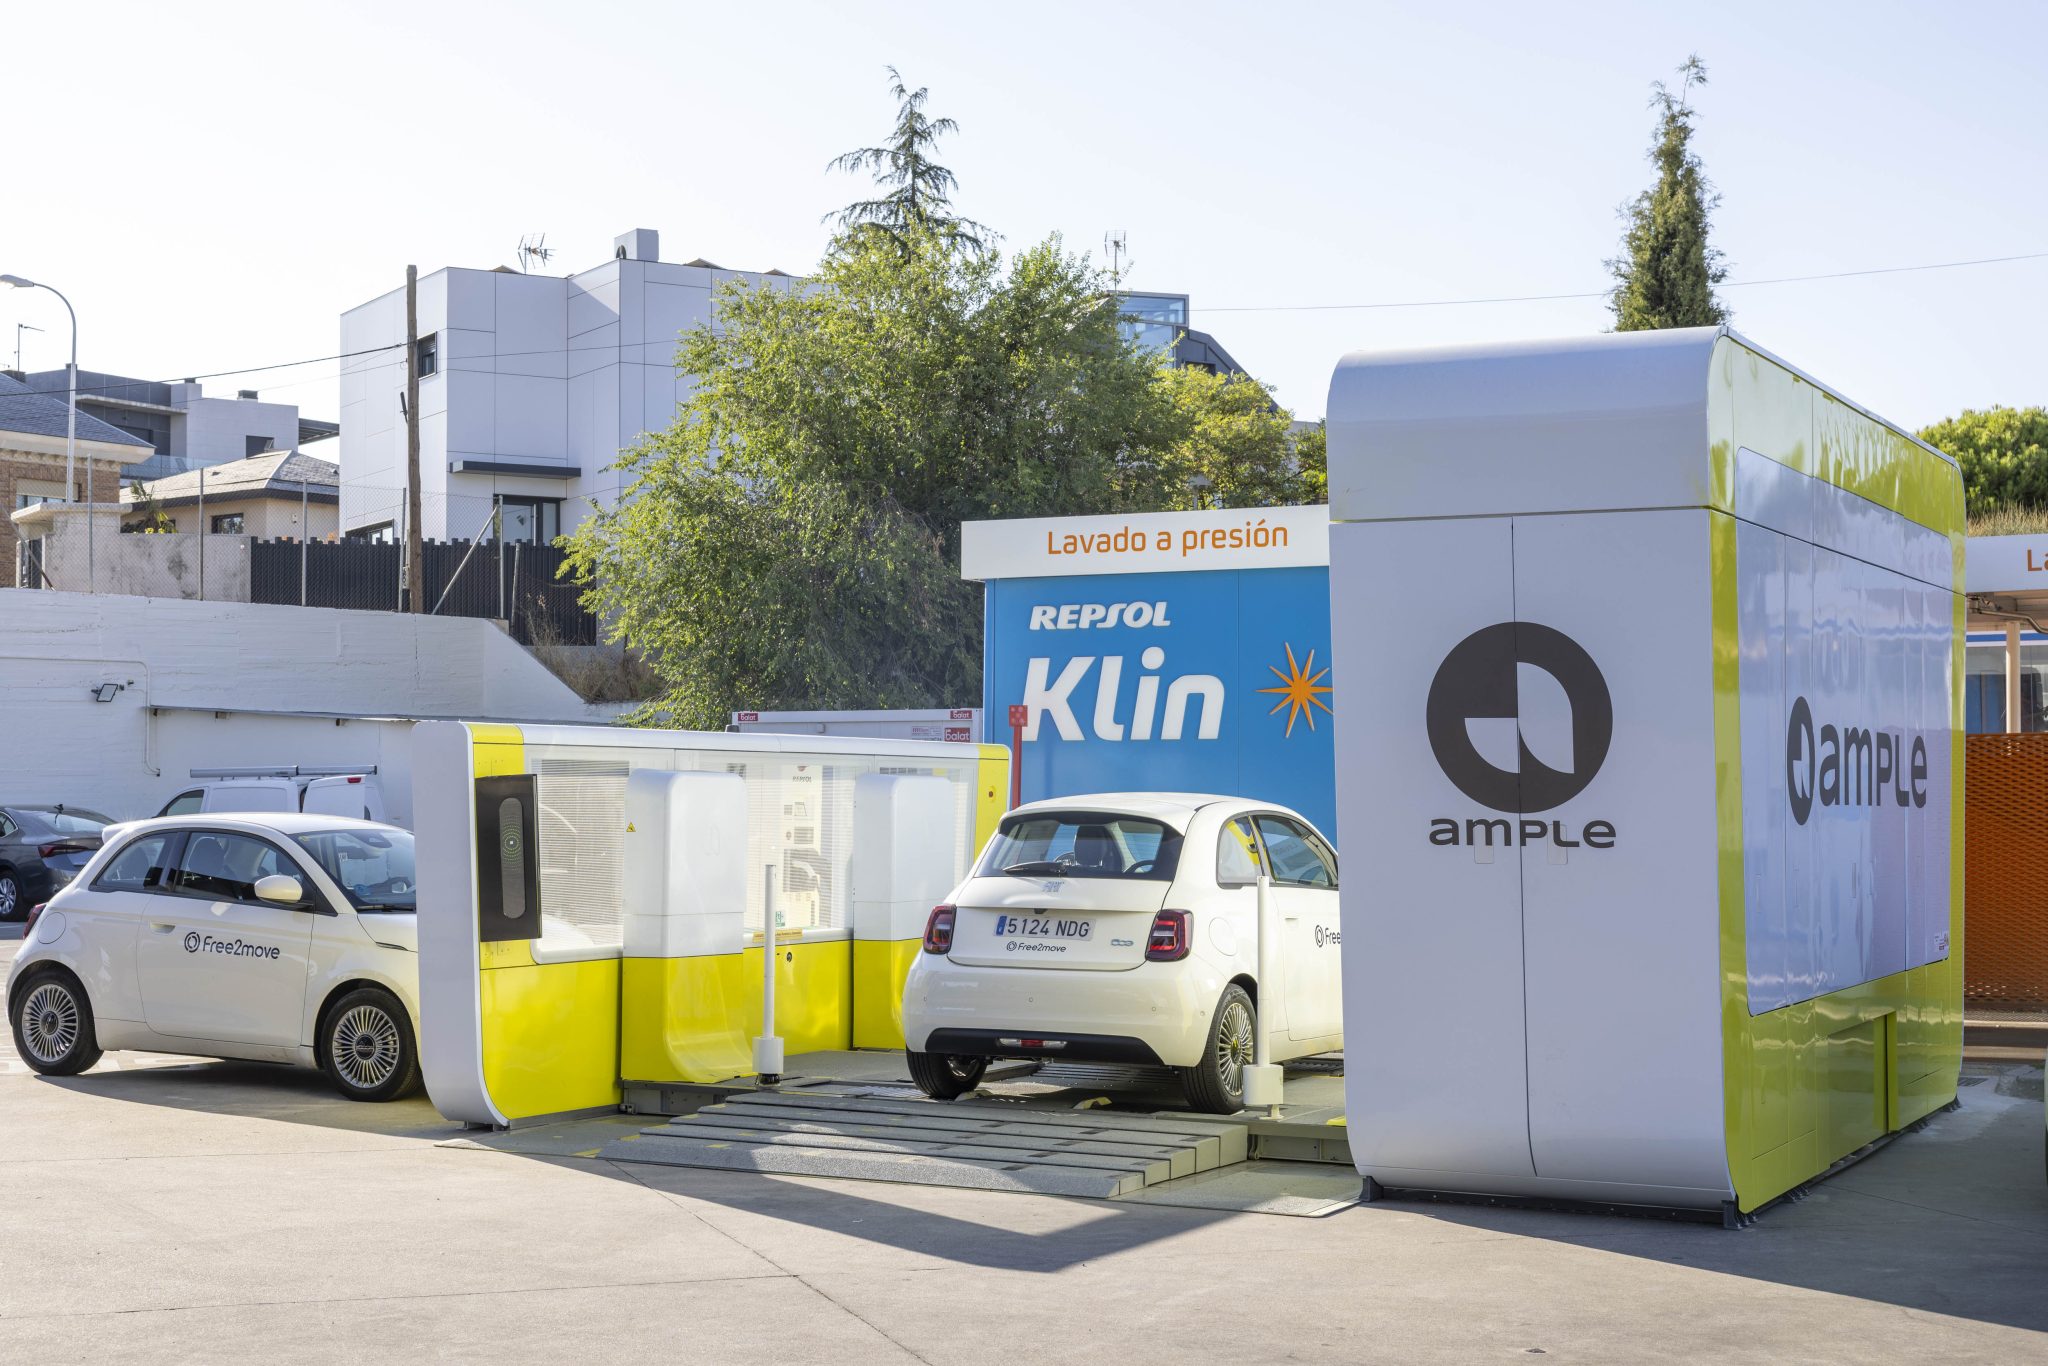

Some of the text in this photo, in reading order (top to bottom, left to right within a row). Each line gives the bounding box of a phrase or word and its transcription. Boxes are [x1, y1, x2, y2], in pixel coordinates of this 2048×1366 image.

[1048, 519, 1288, 557] Lavado a presión
[1029, 601, 1171, 631] REPSOL
[1021, 646, 1225, 741] Klin
[945, 729, 969, 740] balat
[1007, 918, 1090, 937] 5124 NDG
[203, 935, 280, 959] Free2move
[1018, 942, 1067, 953] Free2move
